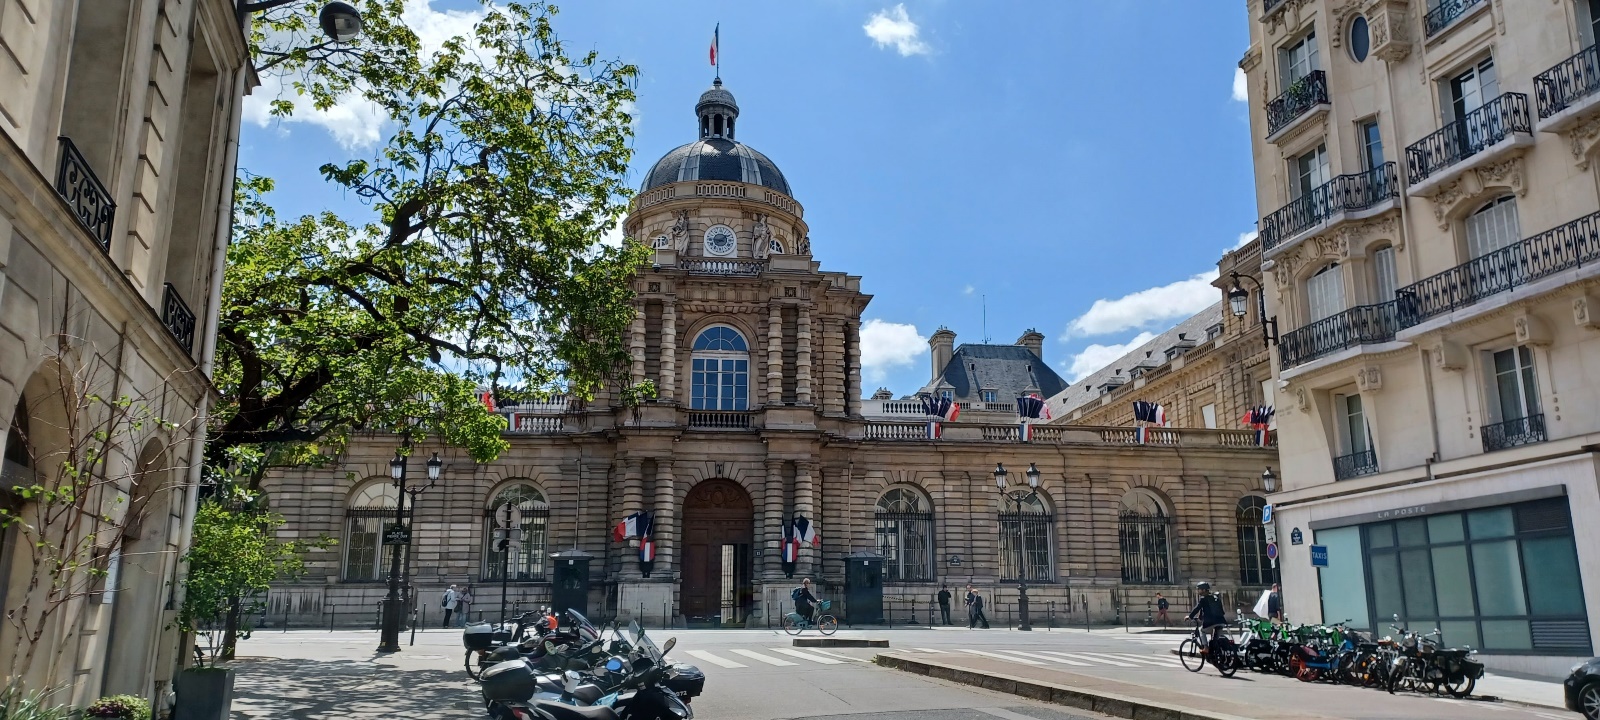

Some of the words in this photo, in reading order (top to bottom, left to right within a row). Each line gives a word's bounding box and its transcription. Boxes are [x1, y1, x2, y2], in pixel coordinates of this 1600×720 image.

[1377, 511, 1389, 519] LA
[1394, 505, 1426, 516] POSTE
[1311, 551, 1327, 560] TAXIS
